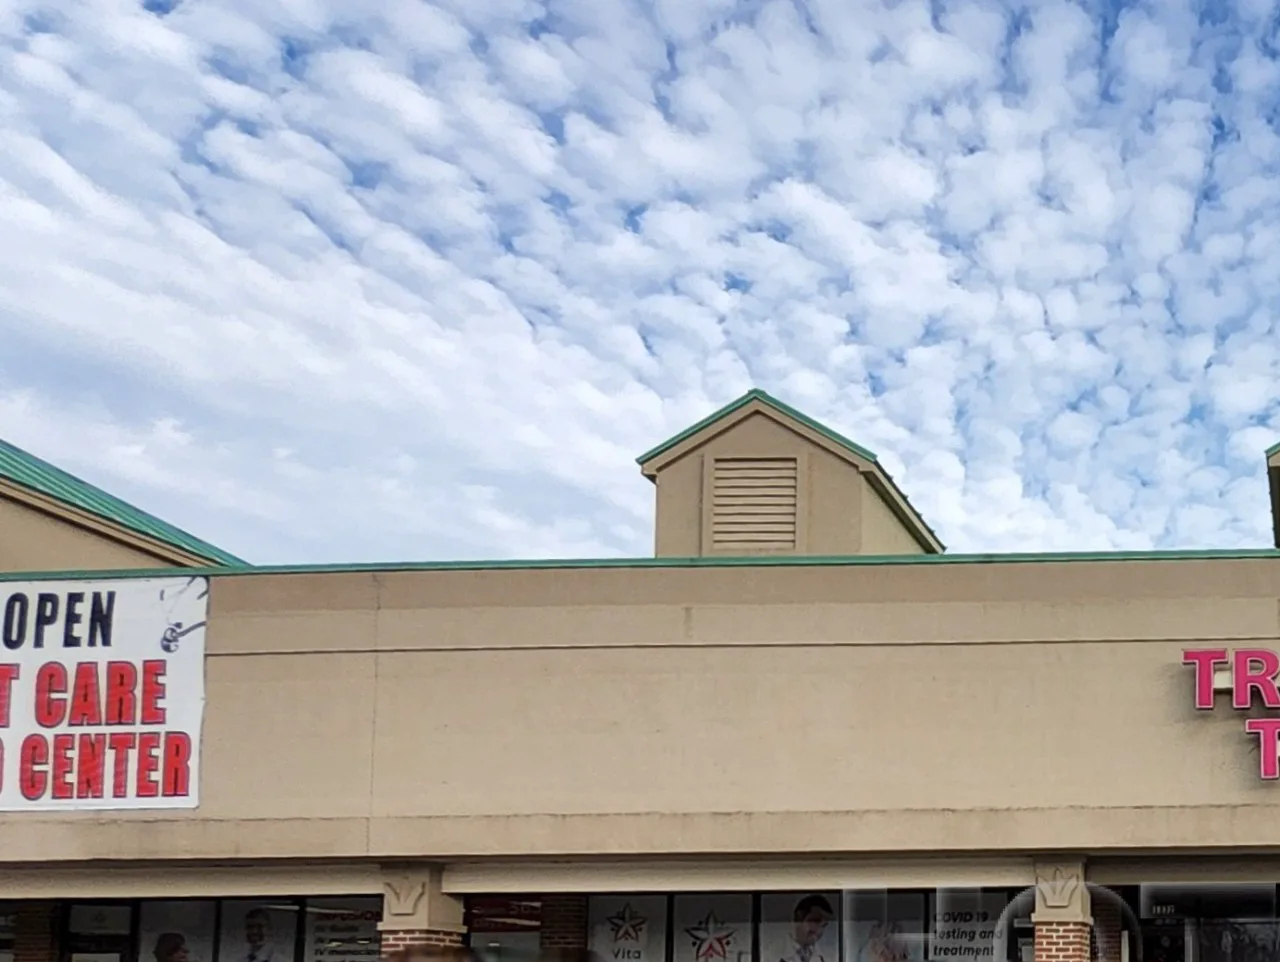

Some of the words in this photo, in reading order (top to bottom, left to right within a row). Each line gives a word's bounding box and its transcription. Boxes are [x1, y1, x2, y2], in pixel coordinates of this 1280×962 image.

[3, 591, 116, 649] OPEN
[35, 659, 167, 728] CARE
[20, 731, 192, 801] CENTER
[934, 911, 973, 923] COVID
[976, 911, 989, 922] 19
[612, 948, 641, 960] Vita
